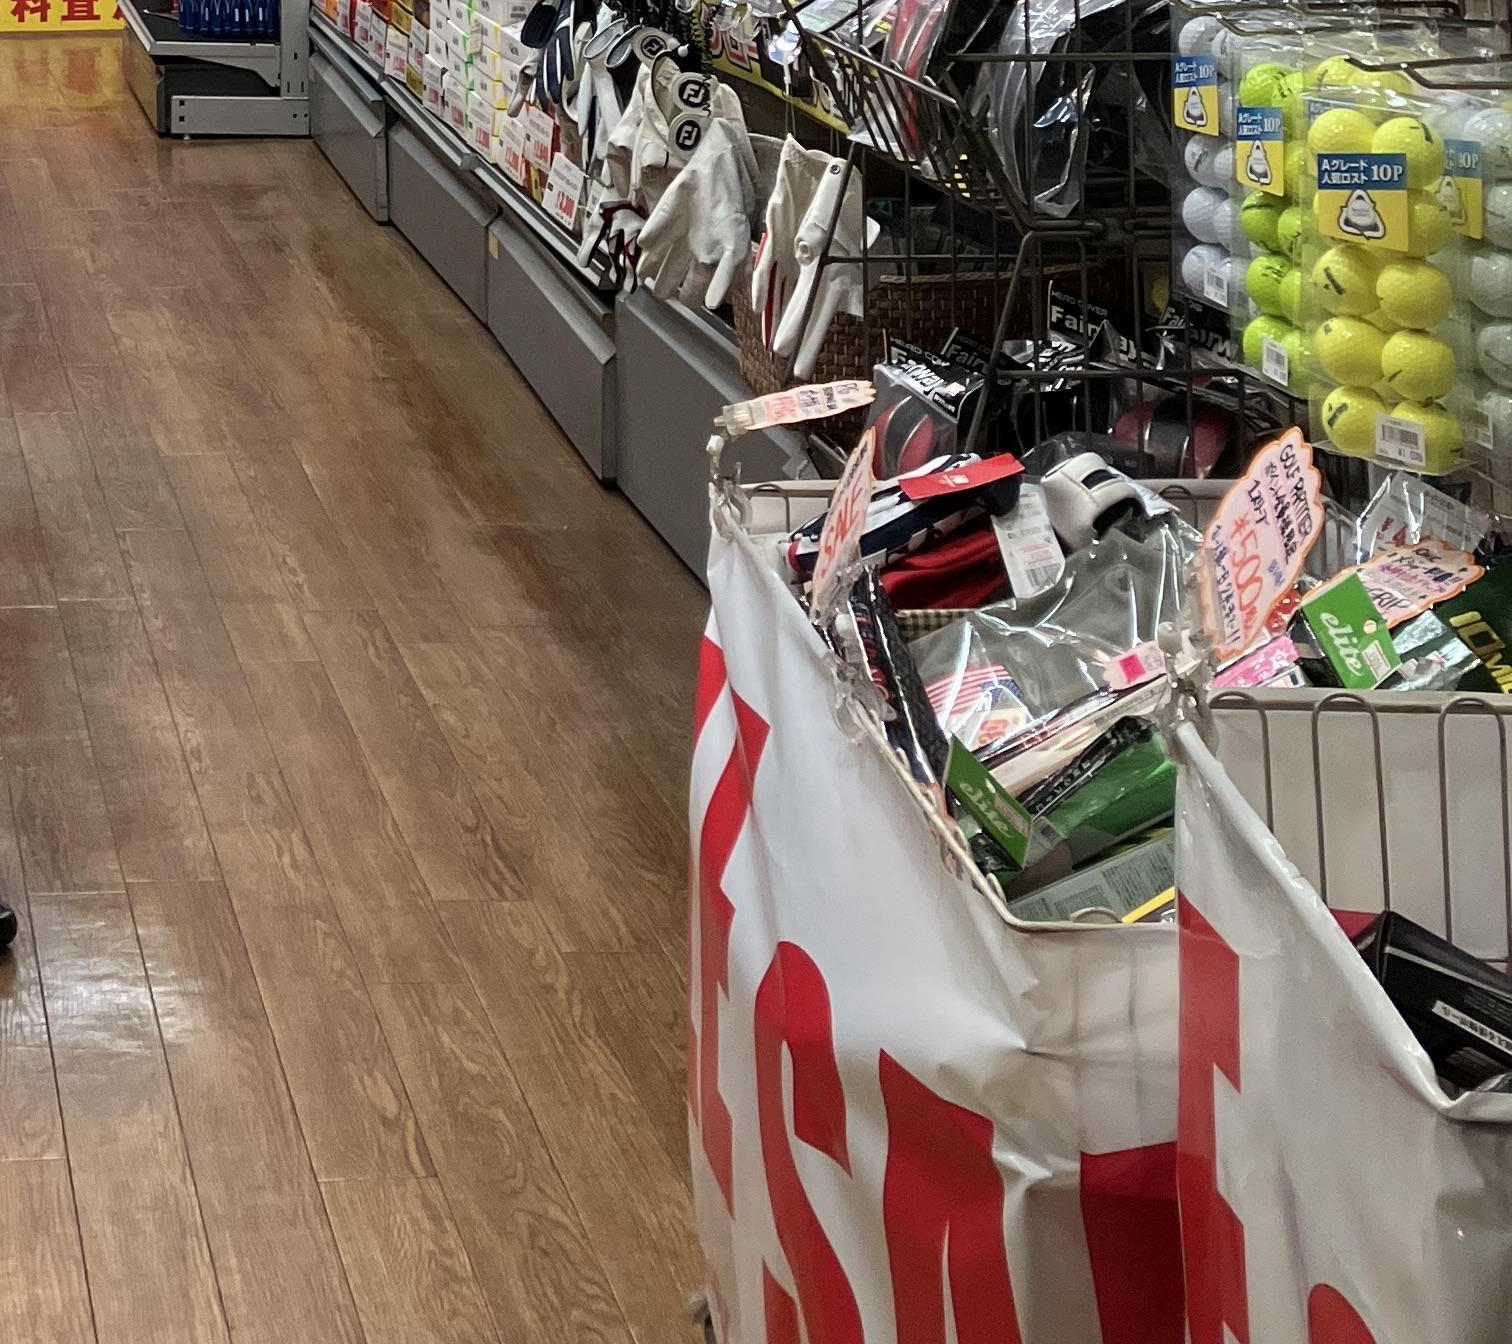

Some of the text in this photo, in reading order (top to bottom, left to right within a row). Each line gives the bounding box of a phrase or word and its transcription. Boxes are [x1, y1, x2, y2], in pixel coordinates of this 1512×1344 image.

[1371, 164, 1403, 182] 10P
[1319, 612, 1363, 678] elite
[959, 781, 1012, 839] elite
